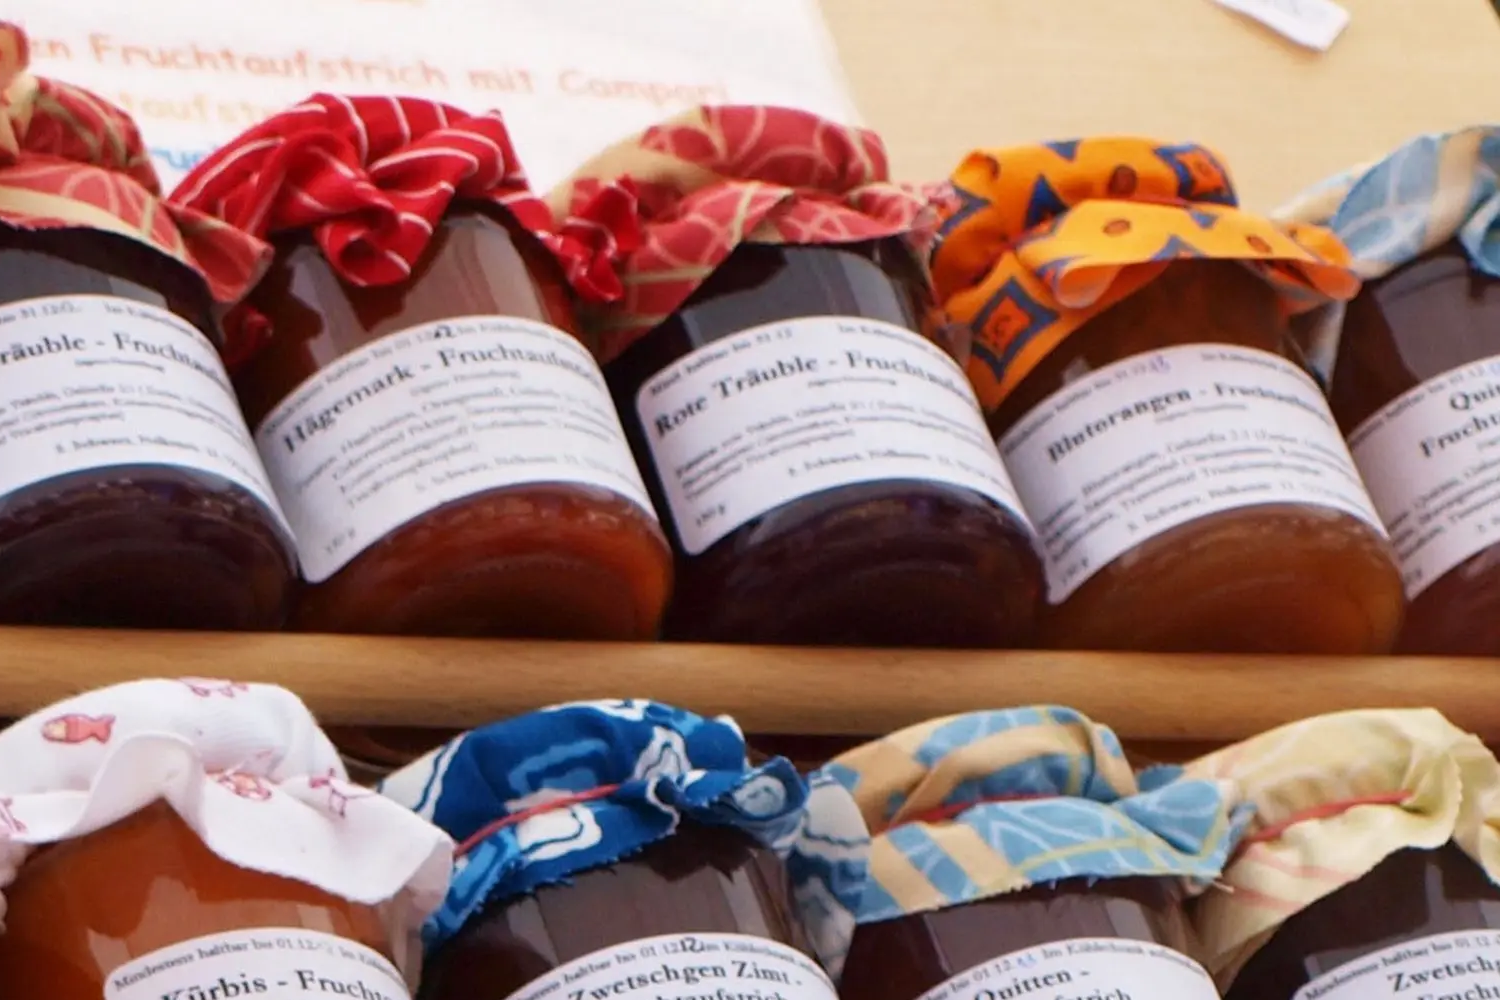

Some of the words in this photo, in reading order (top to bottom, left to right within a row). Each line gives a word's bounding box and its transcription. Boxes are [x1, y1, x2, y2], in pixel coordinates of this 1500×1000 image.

[89, 33, 449, 91] Fruchtaufstrich
[469, 56, 534, 97] mit
[282, 364, 415, 453] Hägemark
[653, 397, 707, 437] Rote
[711, 354, 819, 400] Träuble
[1046, 387, 1192, 464] Blutorangen
[731, 960, 790, 987] Zimt
